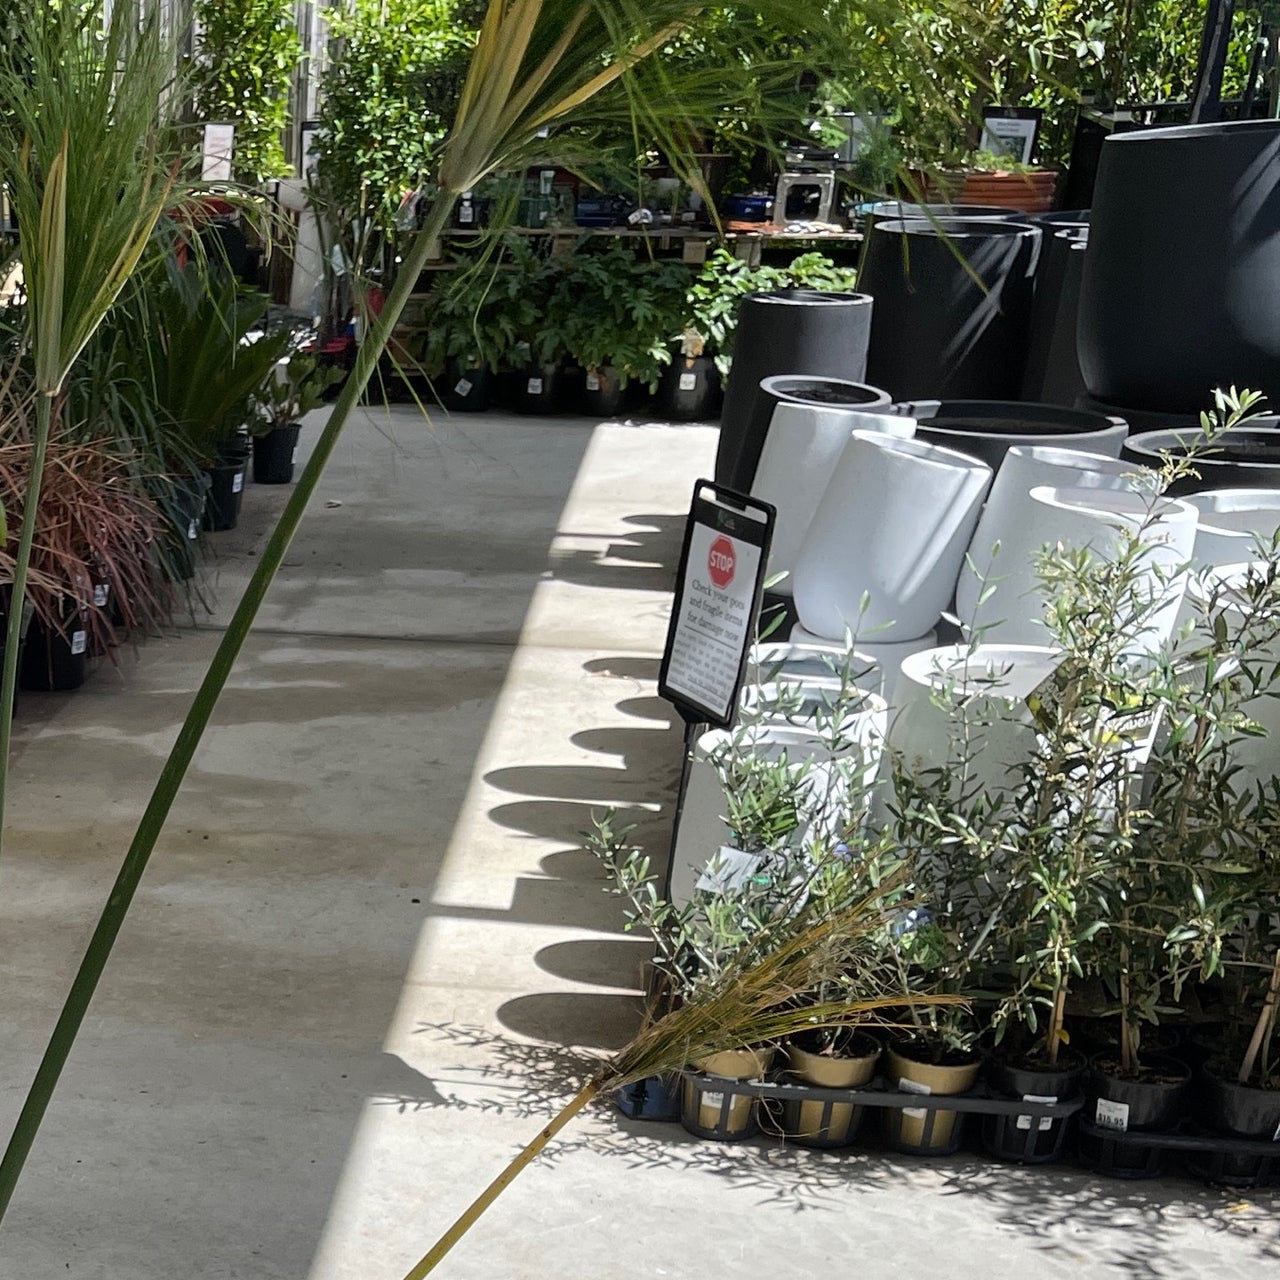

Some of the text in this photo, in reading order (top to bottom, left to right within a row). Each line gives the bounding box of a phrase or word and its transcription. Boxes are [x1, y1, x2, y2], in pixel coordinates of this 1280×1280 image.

[710, 550, 733, 573] STOP
[691, 579, 712, 596] Check
[689, 597, 702, 608] and
[702, 600, 723, 618] fragile
[687, 610, 698, 624] for
[698, 616, 724, 636] damage
